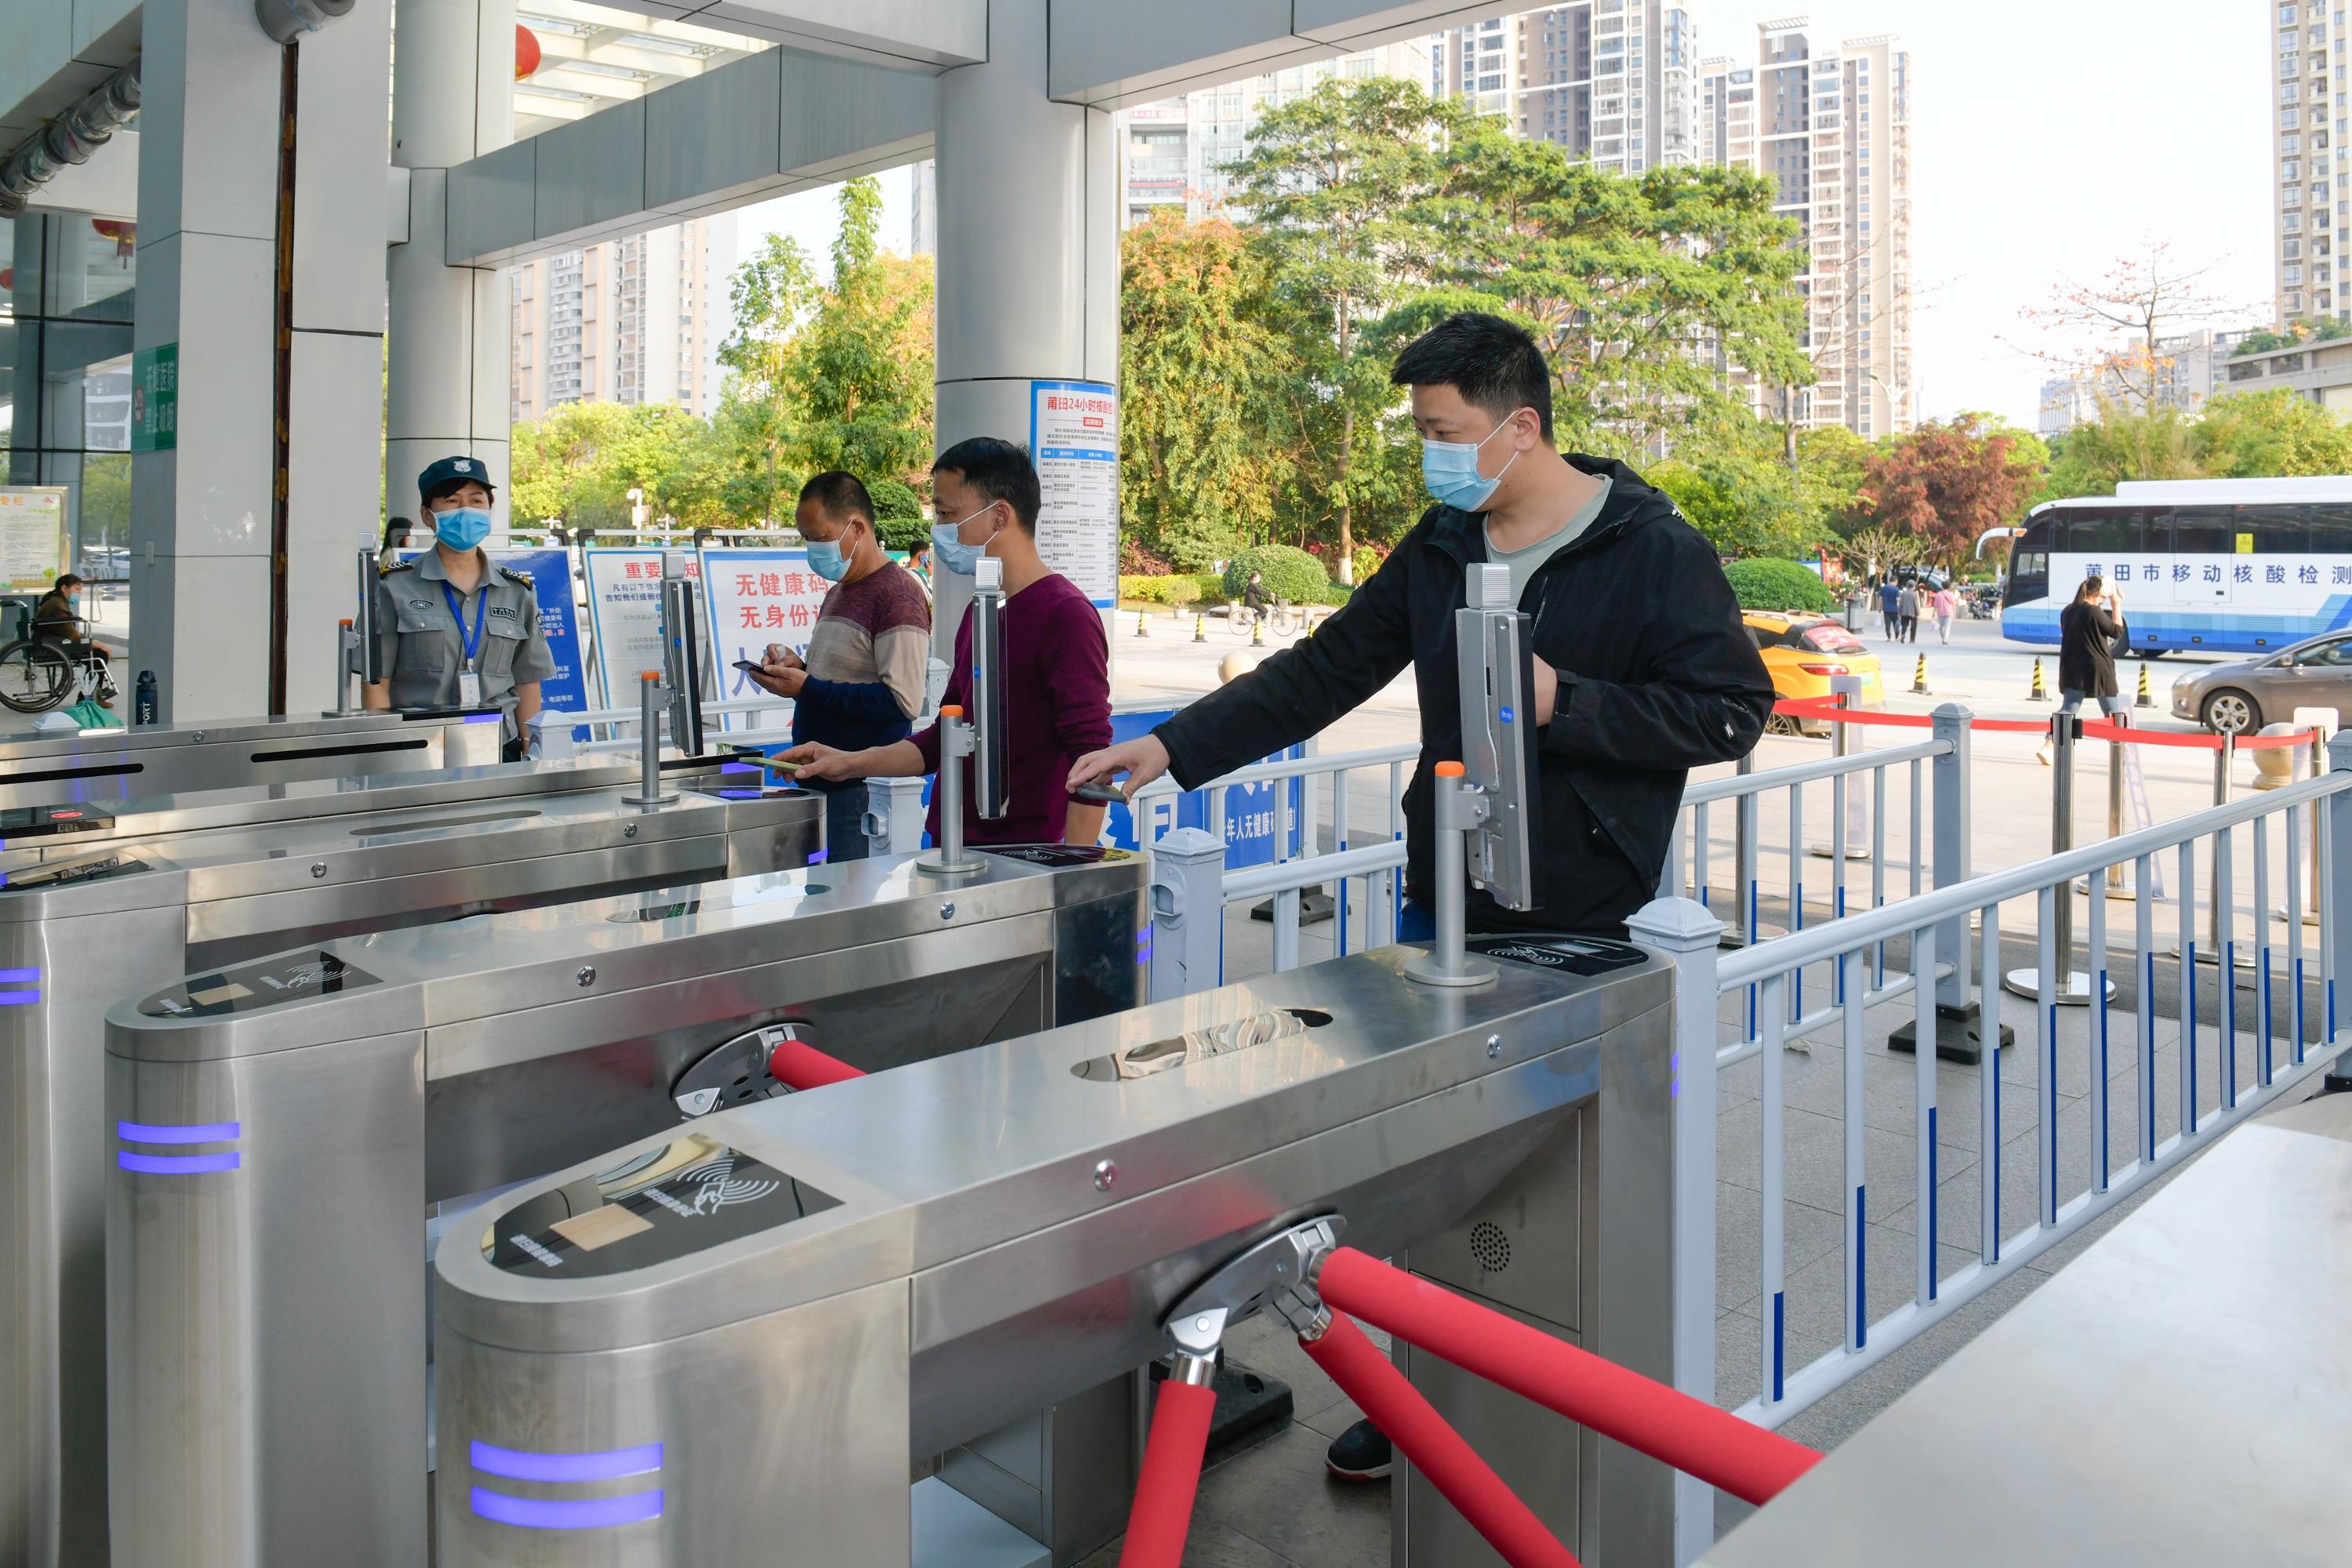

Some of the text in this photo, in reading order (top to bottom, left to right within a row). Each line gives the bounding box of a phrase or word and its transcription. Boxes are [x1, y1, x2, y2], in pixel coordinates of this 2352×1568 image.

[1047, 396, 1115, 415] 莆田24小时核酸检
[624, 562, 700, 579] 重要知
